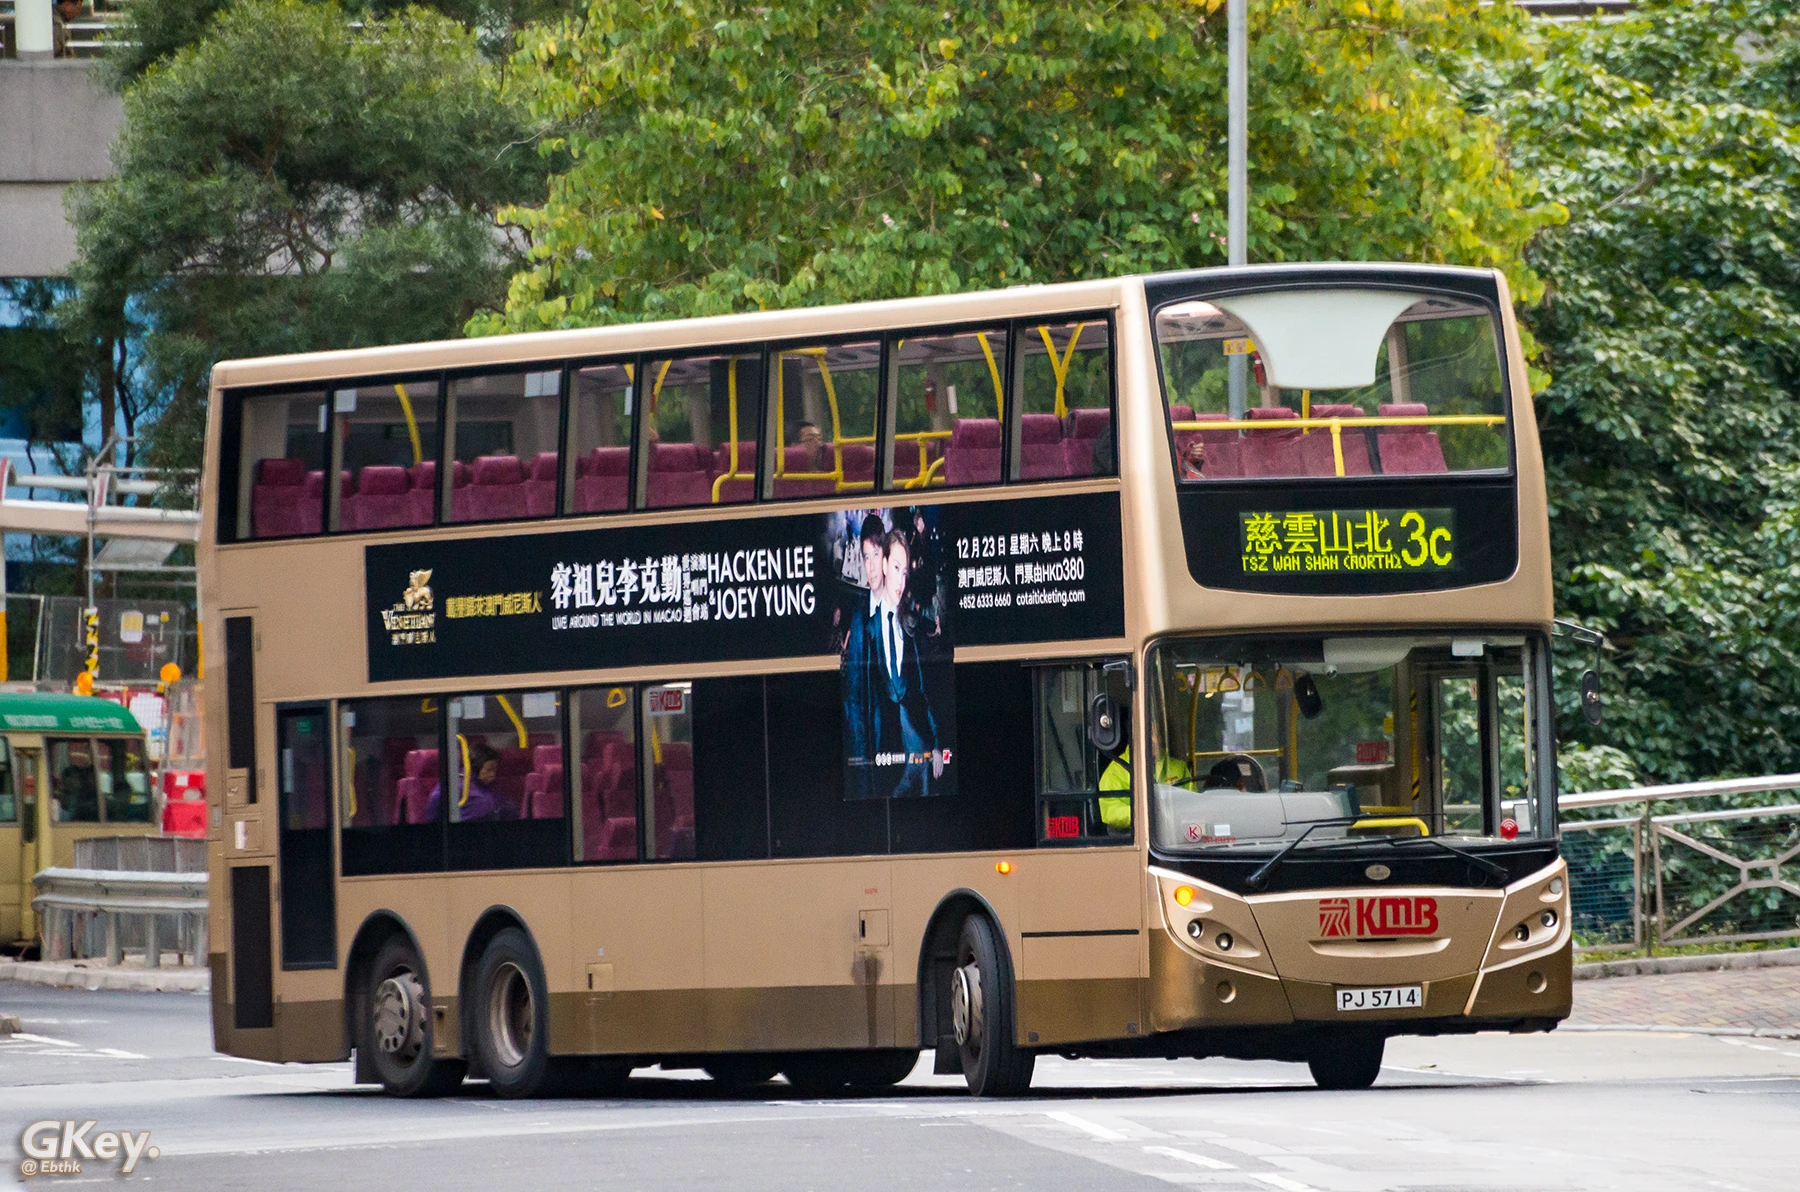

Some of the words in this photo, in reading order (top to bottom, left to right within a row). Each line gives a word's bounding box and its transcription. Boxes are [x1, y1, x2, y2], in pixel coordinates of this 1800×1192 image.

[1010, 532, 1039, 555] 星期六
[1244, 510, 1392, 554] 慈雲山北
[707, 548, 781, 583] HACKEN
[786, 545, 814, 579] LEE
[1242, 556, 1268, 572] TSZ
[1273, 555, 1300, 571] WAN
[1305, 555, 1338, 570] SHAN
[1344, 554, 1402, 570] (NORTH)
[550, 554, 682, 609] 容祖兒李克勤
[958, 565, 1010, 588] 澳門威尼斯人
[714, 586, 758, 620] JOEY
[762, 582, 815, 616] YUNG
[959, 594, 975, 609] +852
[977, 593, 993, 608] 6333
[995, 592, 1011, 607] 6660
[1016, 587, 1085, 607] cotaiticketing.com
[552, 614, 567, 630] LIVE
[569, 612, 599, 629] AROUND
[600, 612, 614, 627] THE
[615, 610, 641, 625] WORLD
[643, 609, 652, 624] IN
[653, 607, 682, 624] MACAO
[1356, 897, 1439, 936] KMB
[1342, 992, 1365, 1008] PJ
[1372, 989, 1416, 1007] 5714
